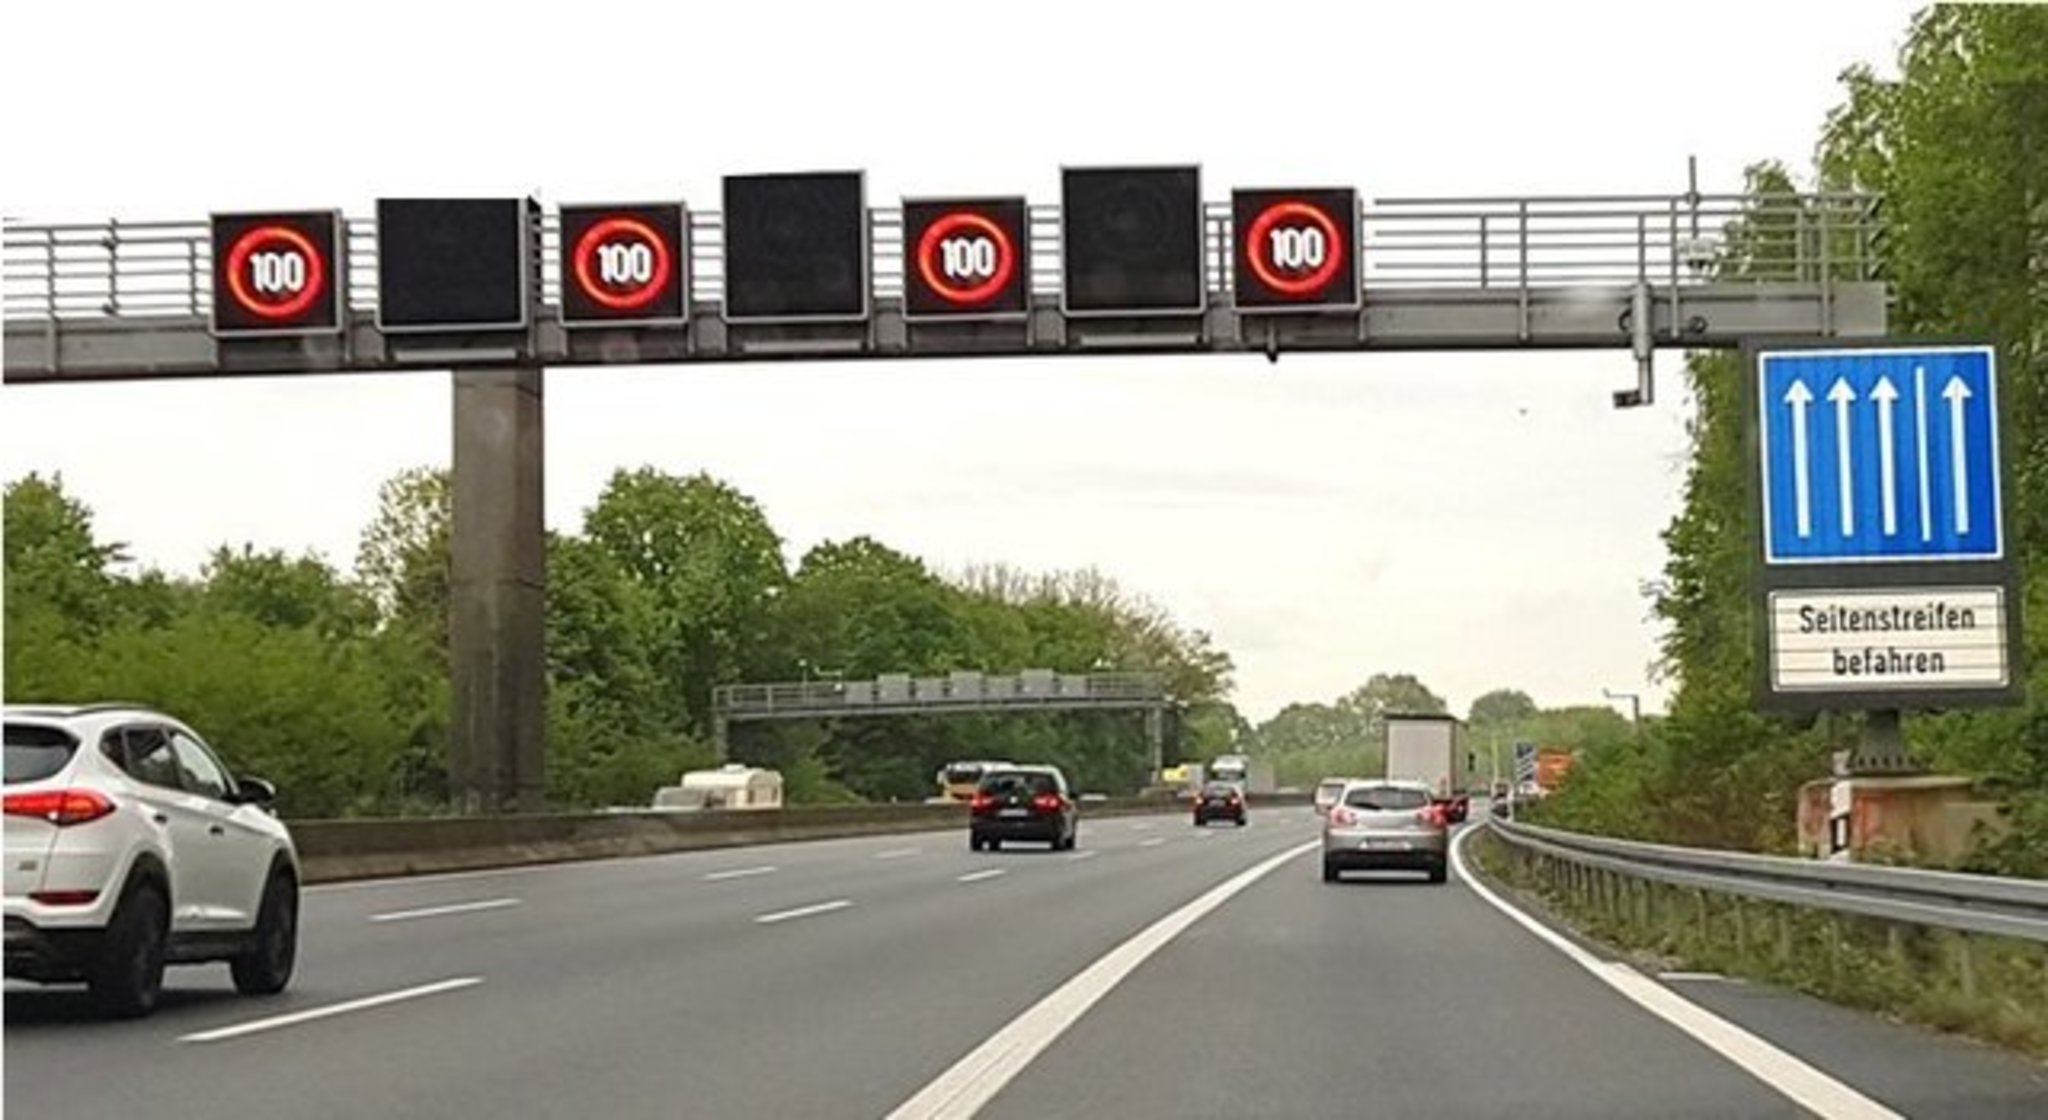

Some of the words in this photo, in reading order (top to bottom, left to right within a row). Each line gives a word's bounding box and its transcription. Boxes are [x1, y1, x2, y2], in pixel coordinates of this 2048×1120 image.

[598, 242, 652, 284] 100
[940, 238, 995, 278] 100
[1269, 226, 1323, 268] 100
[250, 252, 305, 293] 100
[1799, 602, 1976, 633] Seitenstreifen
[1832, 646, 1946, 676] befahren
